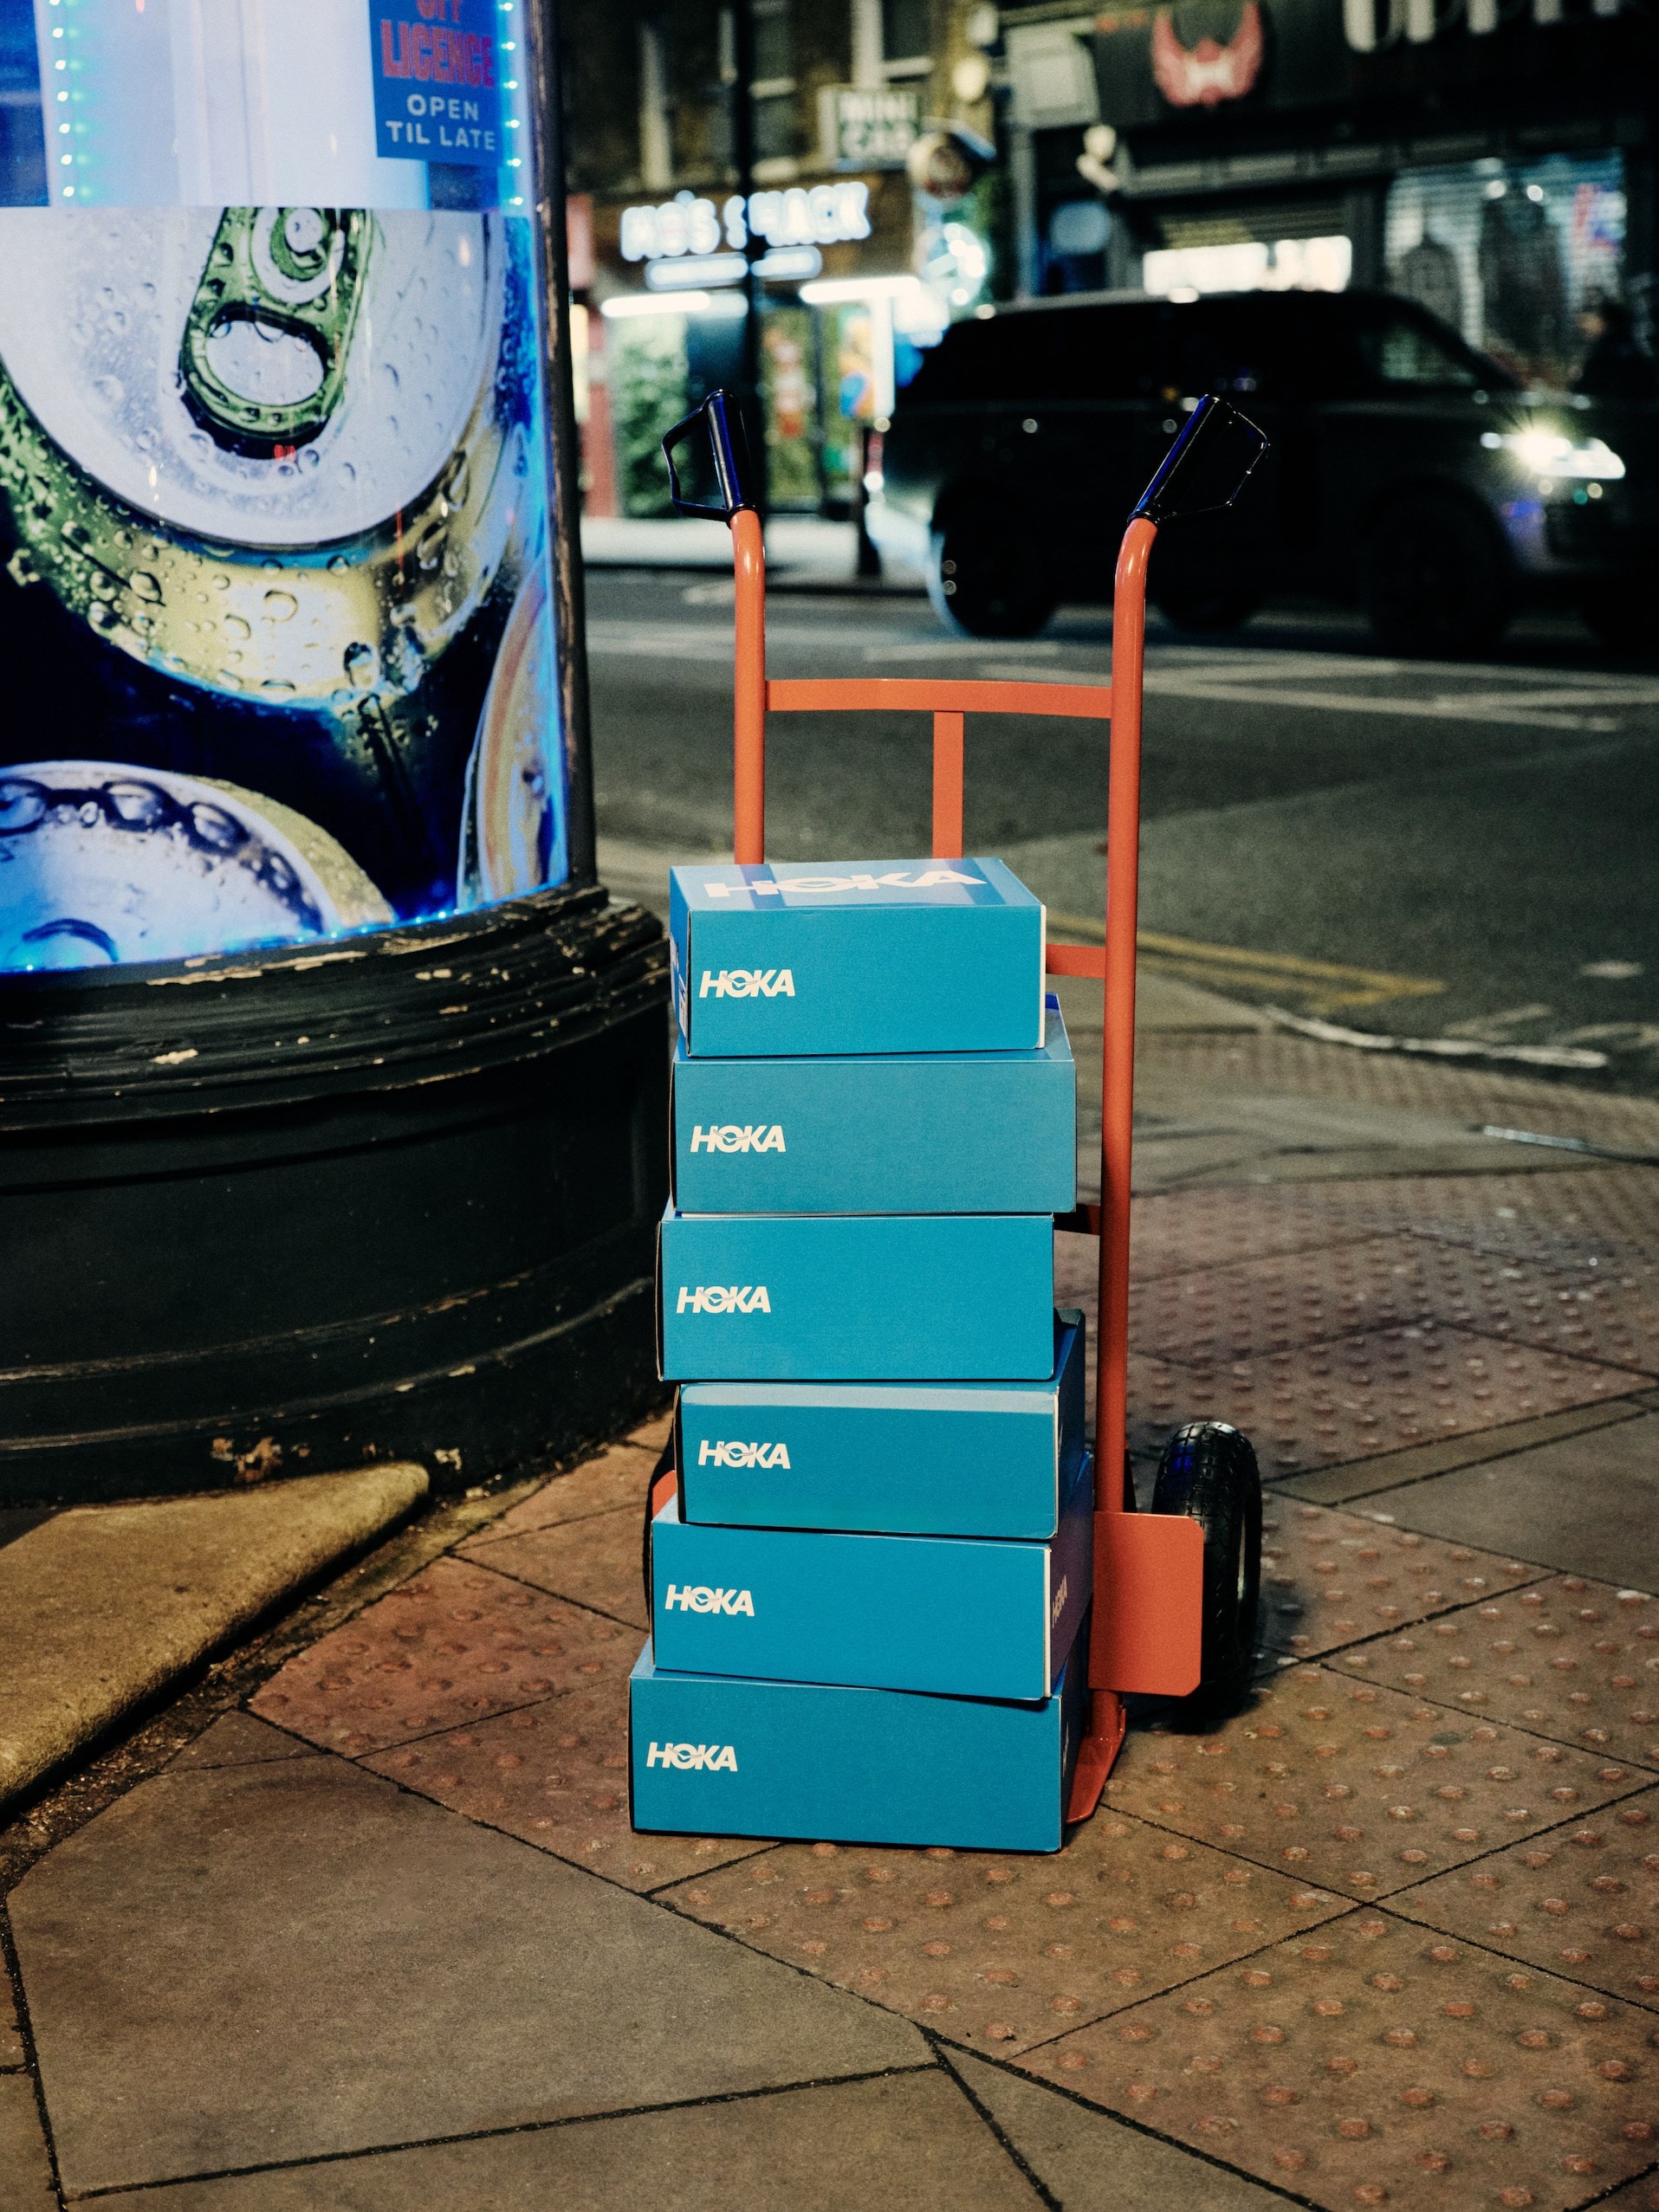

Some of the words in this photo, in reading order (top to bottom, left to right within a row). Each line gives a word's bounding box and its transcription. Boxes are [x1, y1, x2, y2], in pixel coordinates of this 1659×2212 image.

[381, 19, 495, 88] LICENCE
[407, 94, 479, 121] OPEN
[386, 120, 431, 145] TIL
[439, 126, 496, 152] LATE
[703, 870, 988, 898] HOKA
[698, 969, 795, 999] HOKA
[690, 1125, 787, 1154] HOKA
[677, 1286, 772, 1314] HOKA
[697, 1439, 791, 1470] HOKA
[664, 1584, 755, 1617] HOKA
[646, 1742, 738, 1772] HOKA
